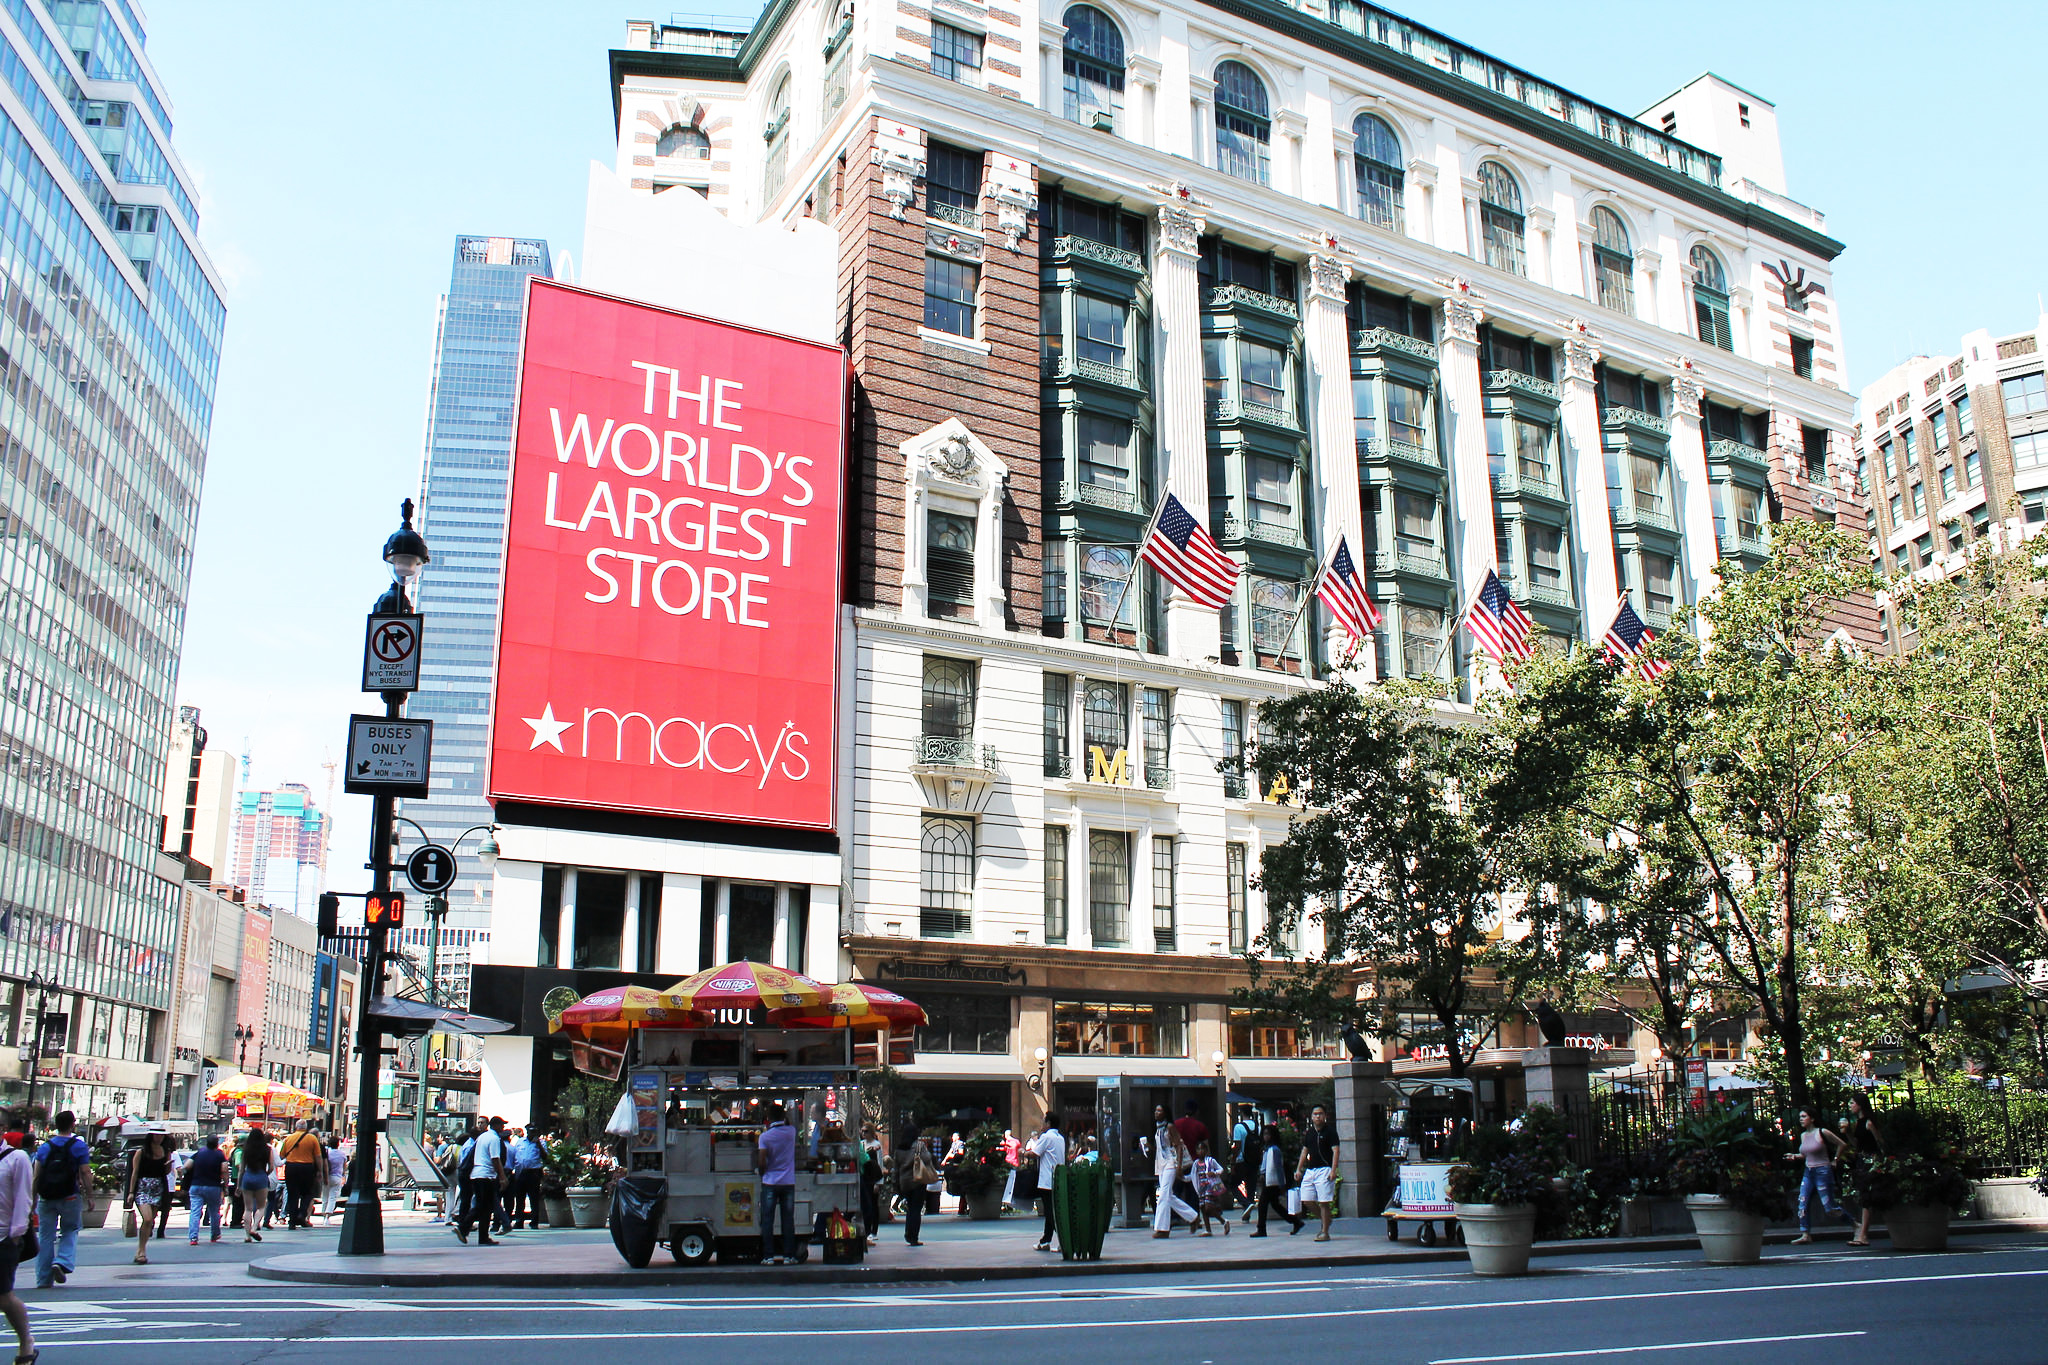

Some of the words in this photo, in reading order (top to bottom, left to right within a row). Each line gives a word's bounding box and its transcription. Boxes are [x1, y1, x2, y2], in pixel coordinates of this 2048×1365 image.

[631, 360, 744, 433] THE
[549, 407, 814, 507] WORLD'S
[544, 471, 807, 568] LARGEST
[584, 547, 770, 629] STORE
[378, 663, 404, 671] EXCEPT
[368, 726, 412, 740] BUSES
[371, 743, 407, 755] ONLY
[374, 769, 389, 777] MON
[406, 770, 417, 778] FRI
[1088, 745, 1130, 786] M
[340, 1026, 350, 1055] KAY
